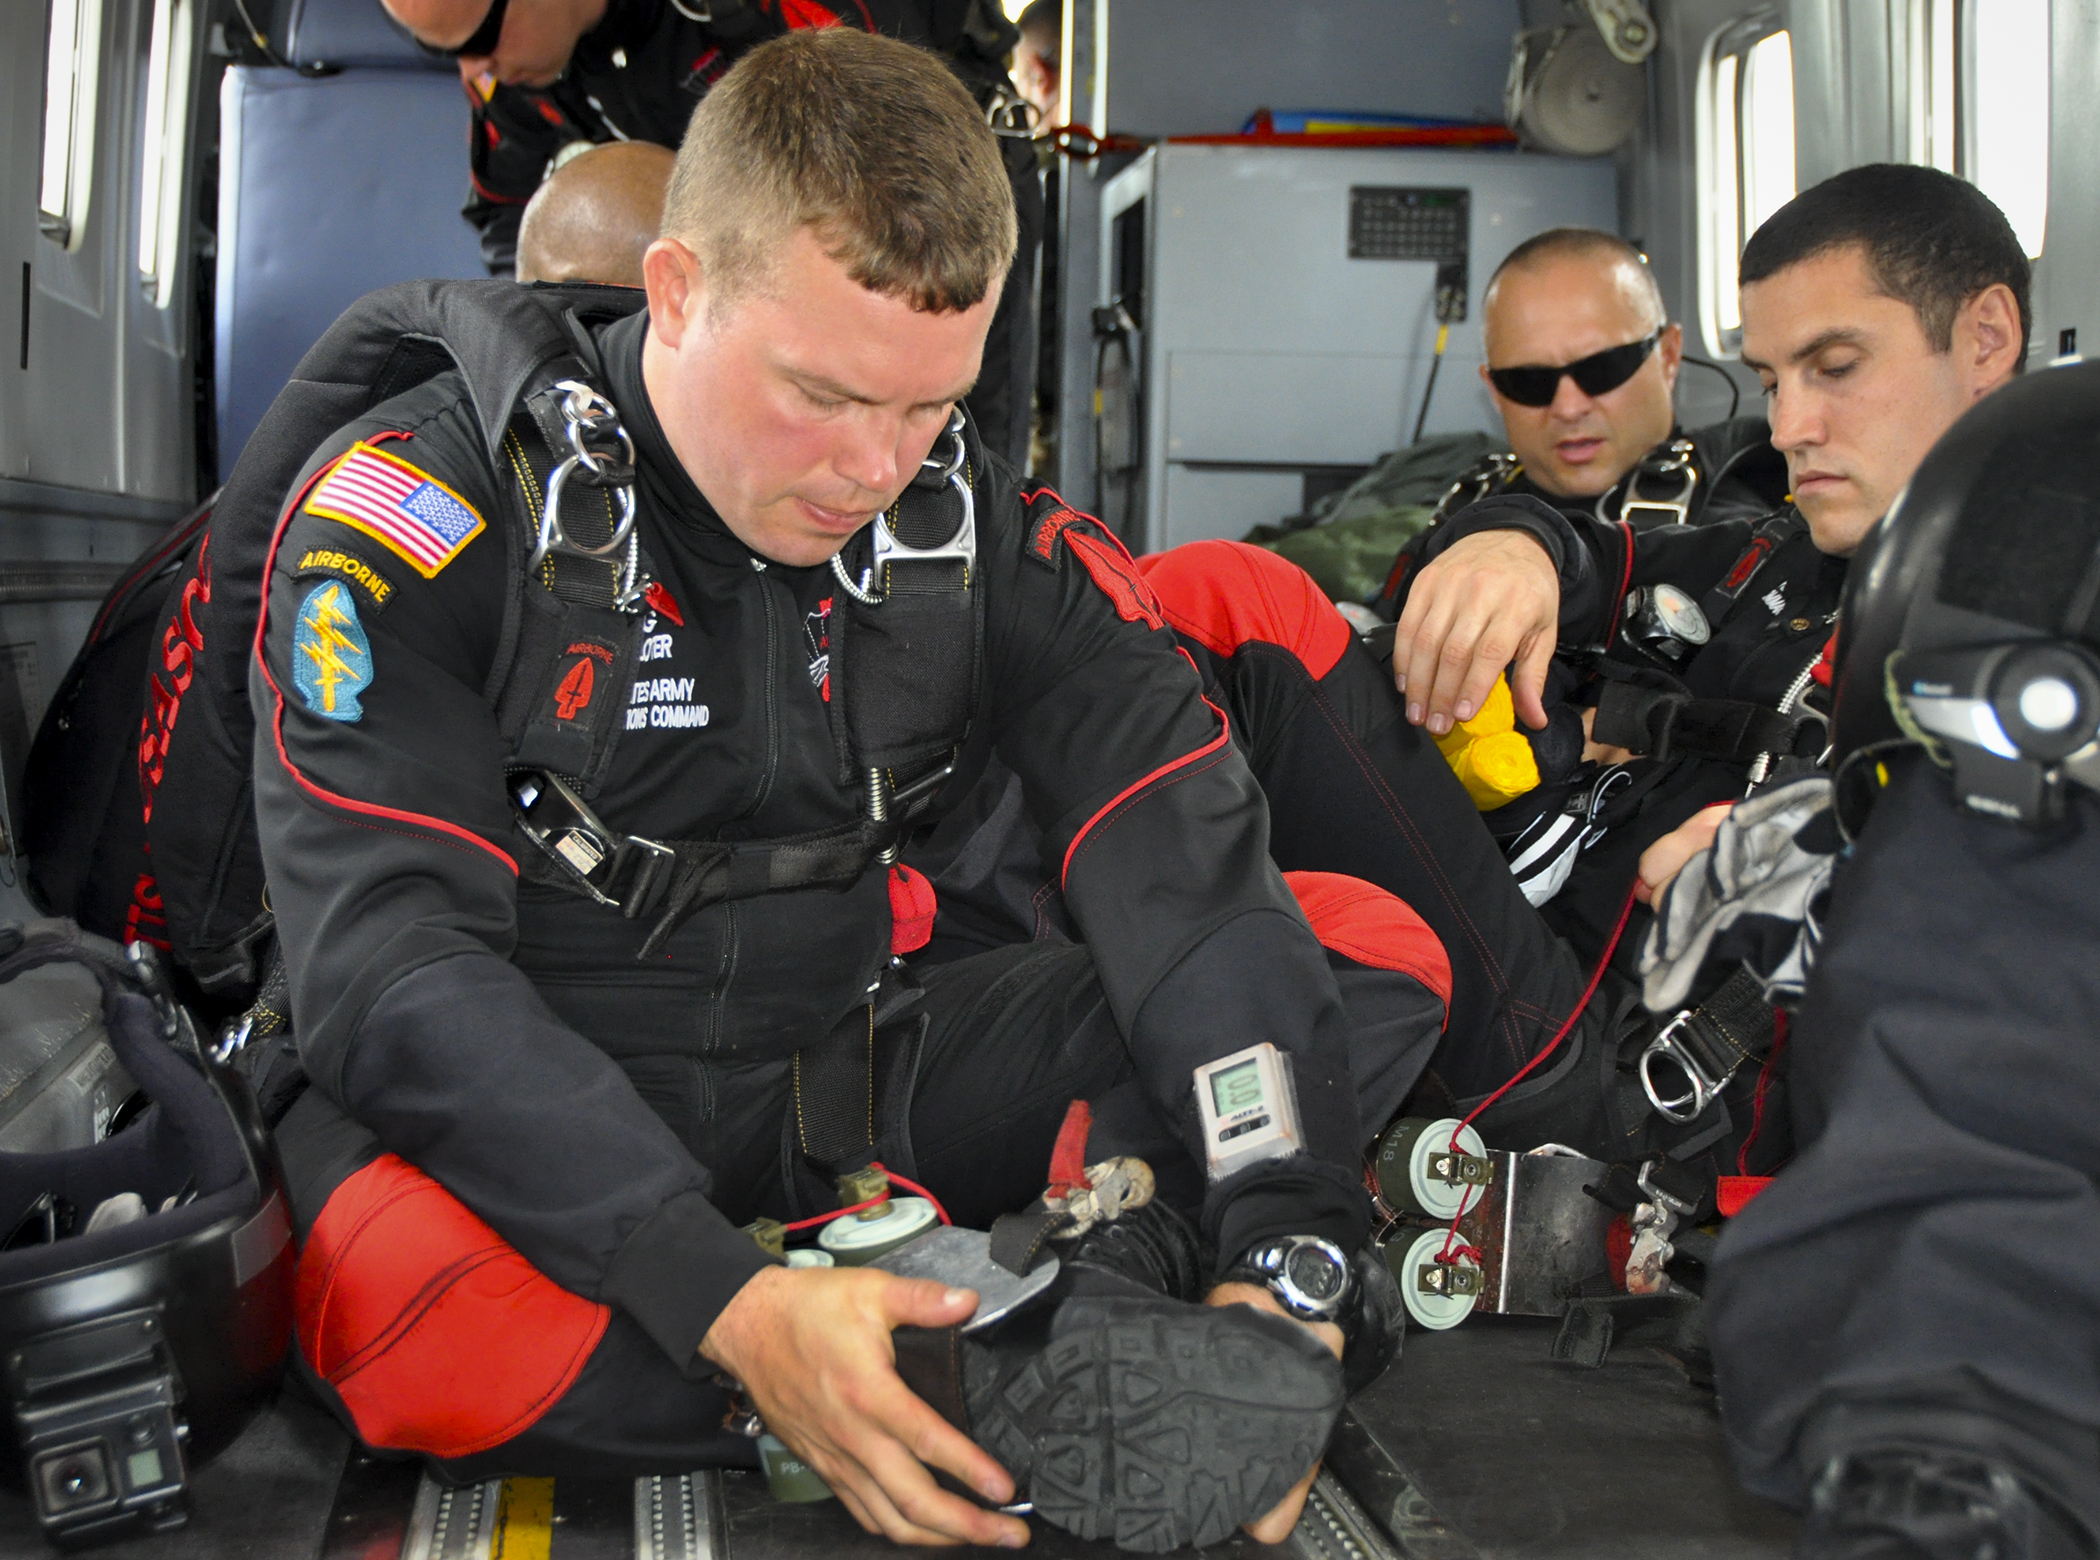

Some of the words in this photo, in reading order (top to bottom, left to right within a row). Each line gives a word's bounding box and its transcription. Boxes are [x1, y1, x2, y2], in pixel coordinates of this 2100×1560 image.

[300, 550, 391, 603] AIRBORNE
[567, 642, 614, 665] AIRBORNE
[630, 681, 650, 705] TES
[650, 677, 696, 702] ARMY
[650, 705, 709, 728] COMMAND
[1383, 1125, 1410, 1161] M18
